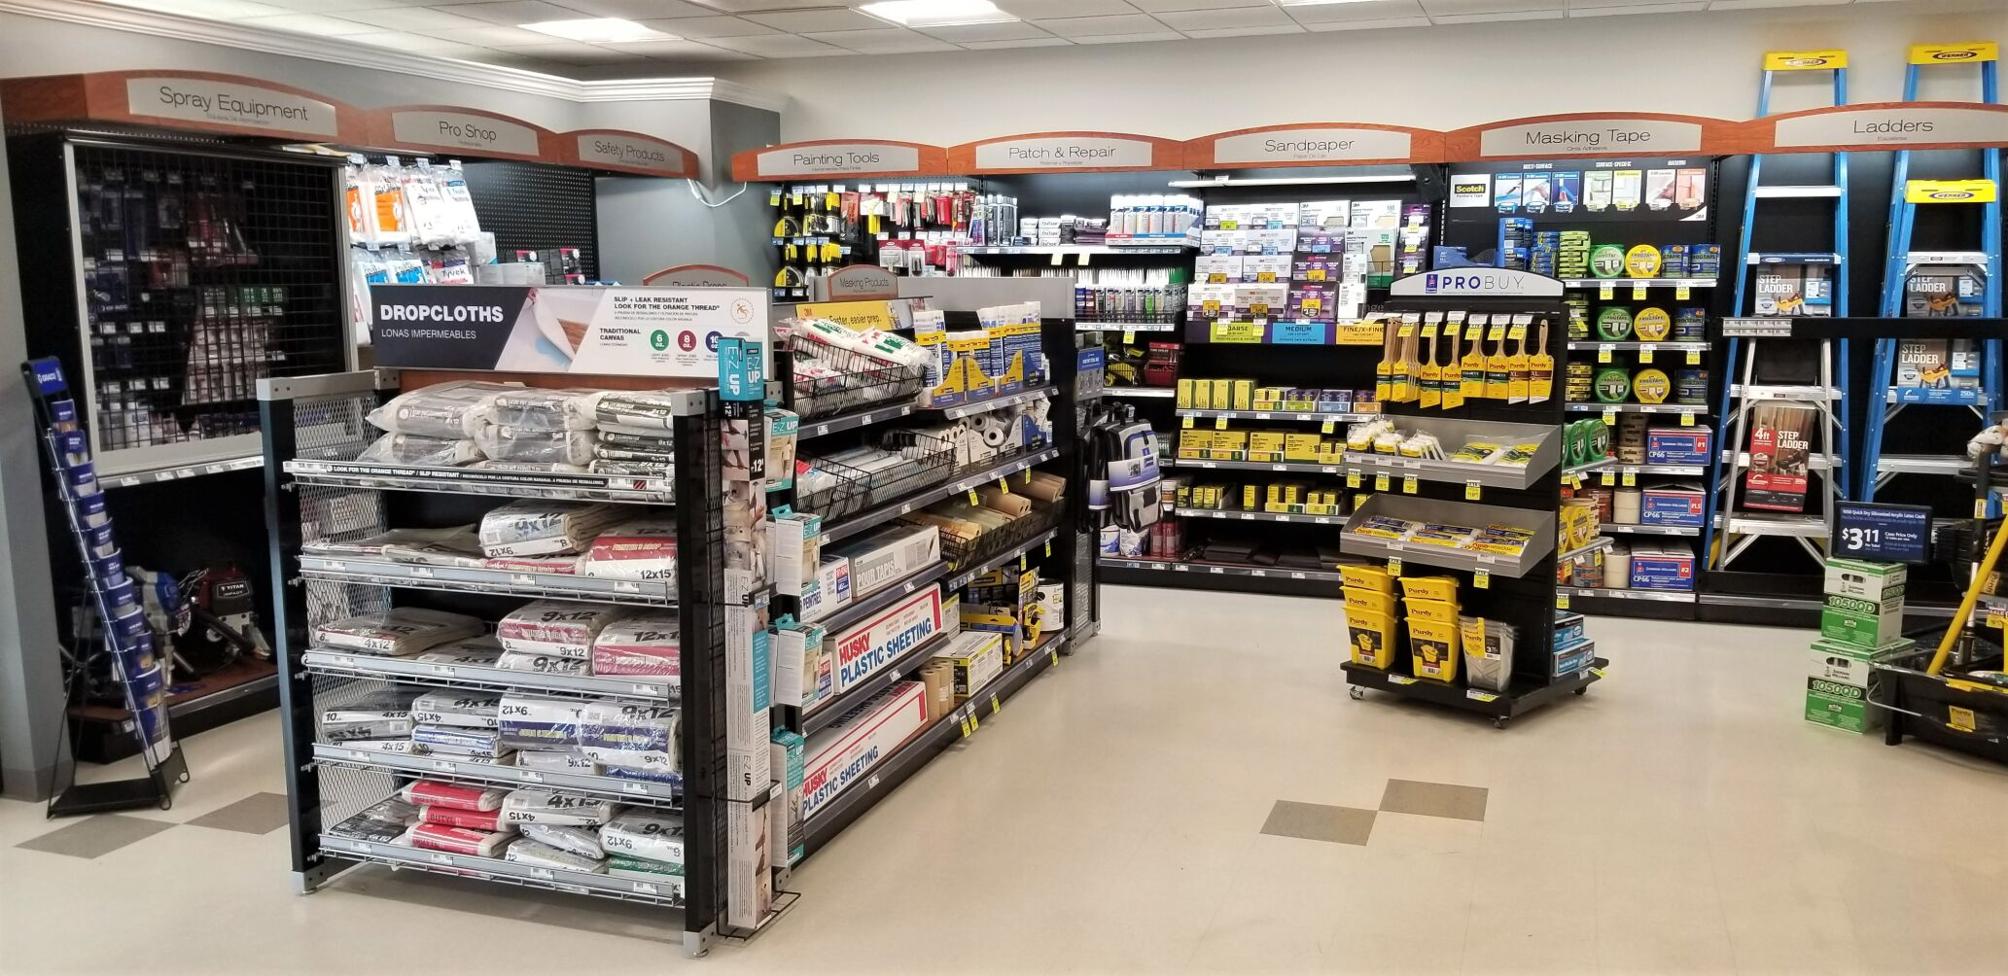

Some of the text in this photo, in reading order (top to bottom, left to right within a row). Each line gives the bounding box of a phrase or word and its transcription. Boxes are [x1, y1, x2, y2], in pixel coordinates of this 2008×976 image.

[159, 86, 309, 121] Spray Equipment
[438, 120, 497, 143] Pro Shop
[1853, 119, 1934, 134] Ladders
[1525, 128, 1651, 147] Masking Tape
[594, 140, 665, 163] Safety Products
[1264, 137, 1355, 157] Sandpaper
[1008, 146, 1116, 160] Patch & Repair
[793, 151, 880, 167] Painting Tools
[1455, 185, 1485, 194] Scotch
[840, 278, 889, 289] Masking Products
[1760, 275, 1781, 284] STEP
[1759, 284, 1793, 293] LADDER
[1910, 283, 1946, 292] LADDER
[380, 304, 504, 323] DROPCLOTHS
[850, 315, 866, 324] easier
[866, 315, 882, 324] prep.
[381, 328, 477, 339] LONAS IMPERMEABLES
[656, 334, 663, 343] 6
[684, 334, 691, 343] 8
[1901, 344, 1926, 354] STEP
[1901, 354, 1939, 364] LADDER
[748, 371, 760, 384] UP
[729, 374, 740, 395] UP
[786, 421, 797, 430] UP
[1778, 431, 1799, 440] STEP
[1777, 440, 1808, 450] LADDER
[640, 570, 671, 580] 12x15
[1408, 586, 1430, 595] Purdy
[541, 611, 598, 622] 9x12
[1411, 608, 1432, 617] Purdy
[1350, 617, 1368, 627] Purdy
[319, 632, 326, 641] 6
[1412, 627, 1433, 637] Purdy
[1464, 634, 1482, 642] Purdy
[364, 639, 390, 649] 4x12
[839, 632, 870, 665] HUSKY
[559, 646, 585, 657] 9x12
[840, 617, 932, 687] PLASTIC SHEETING
[502, 705, 528, 715] 9x12
[326, 713, 337, 721] 10
[417, 712, 442, 722] 4x15
[382, 742, 404, 751] 4x15
[644, 755, 669, 766] 9x12
[803, 745, 879, 815] PLASTIC SHEETING
[803, 767, 828, 797] HUSKY
[508, 811, 536, 821] 4x15
[606, 835, 632, 849] 9x12
